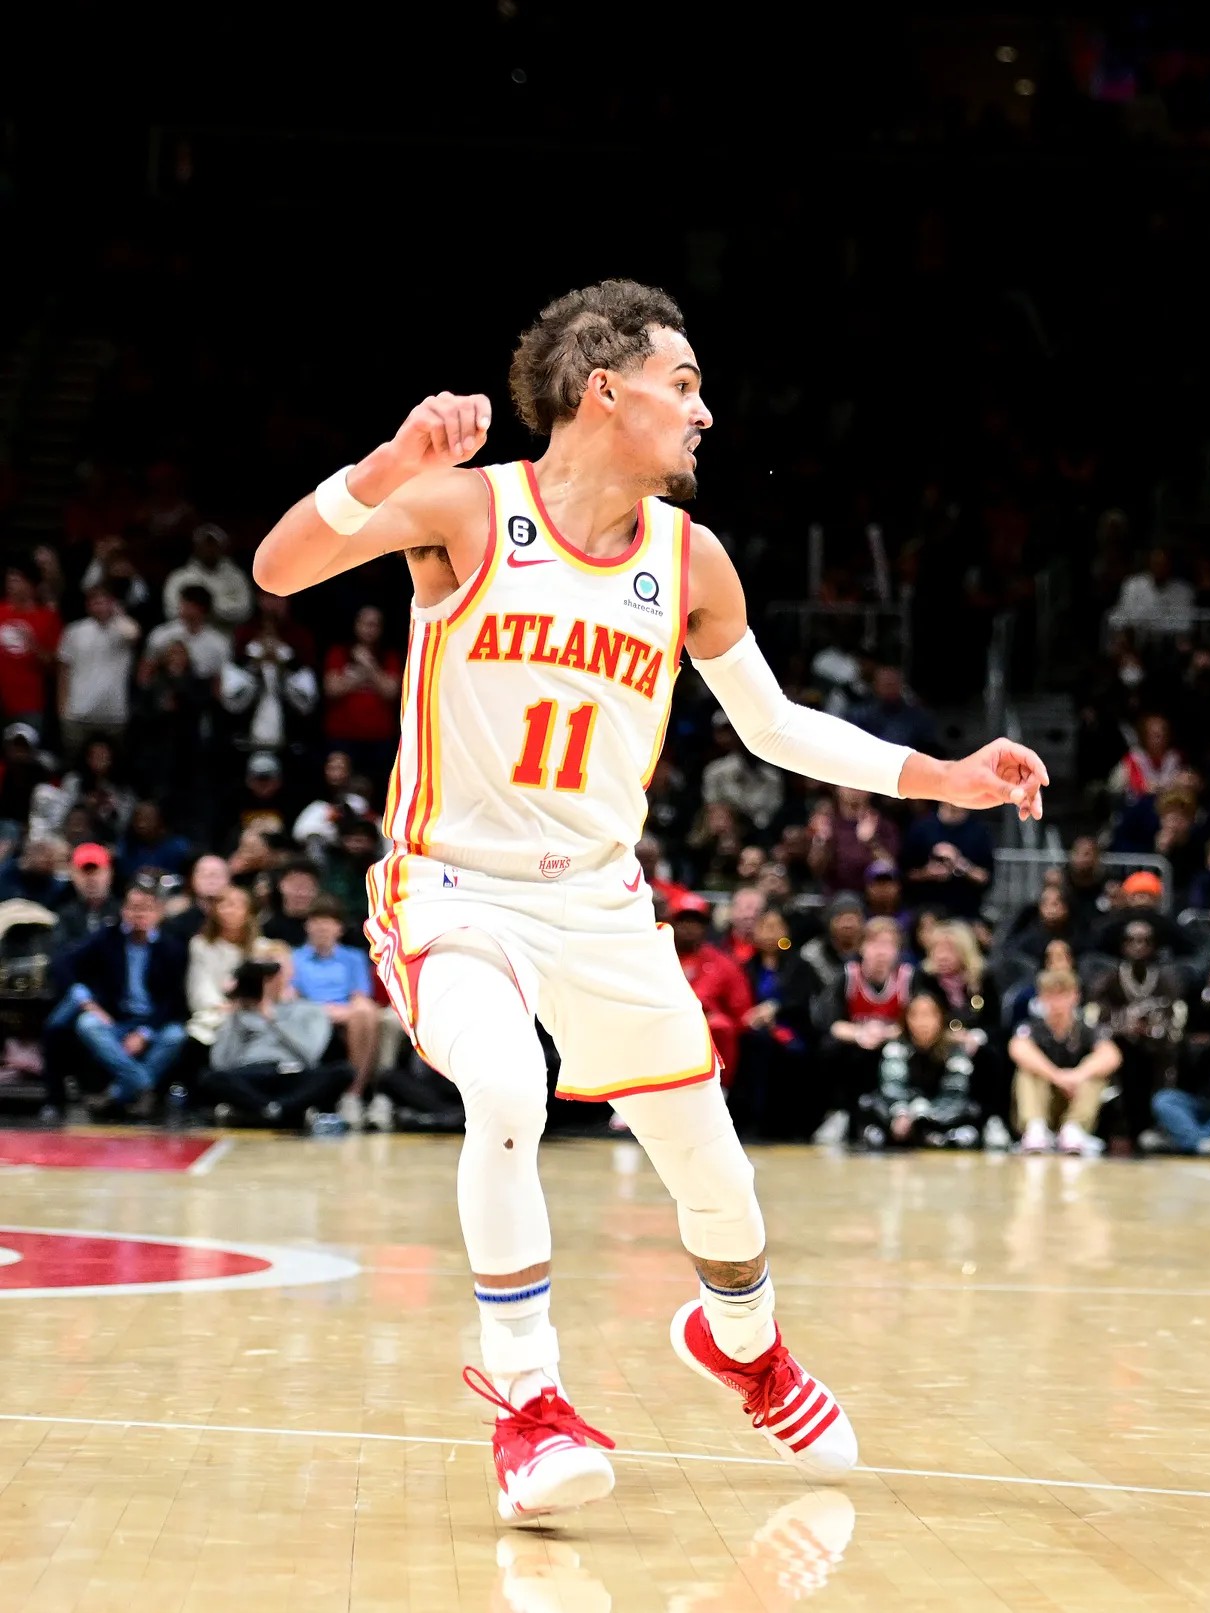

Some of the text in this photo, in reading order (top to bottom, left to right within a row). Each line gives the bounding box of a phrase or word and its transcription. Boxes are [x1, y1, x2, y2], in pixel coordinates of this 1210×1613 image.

[512, 519, 530, 544] 6
[623, 599, 664, 617] sharecare
[466, 613, 665, 701] ATLANTA
[510, 697, 599, 793] 11
[539, 857, 571, 870] HAWKS
